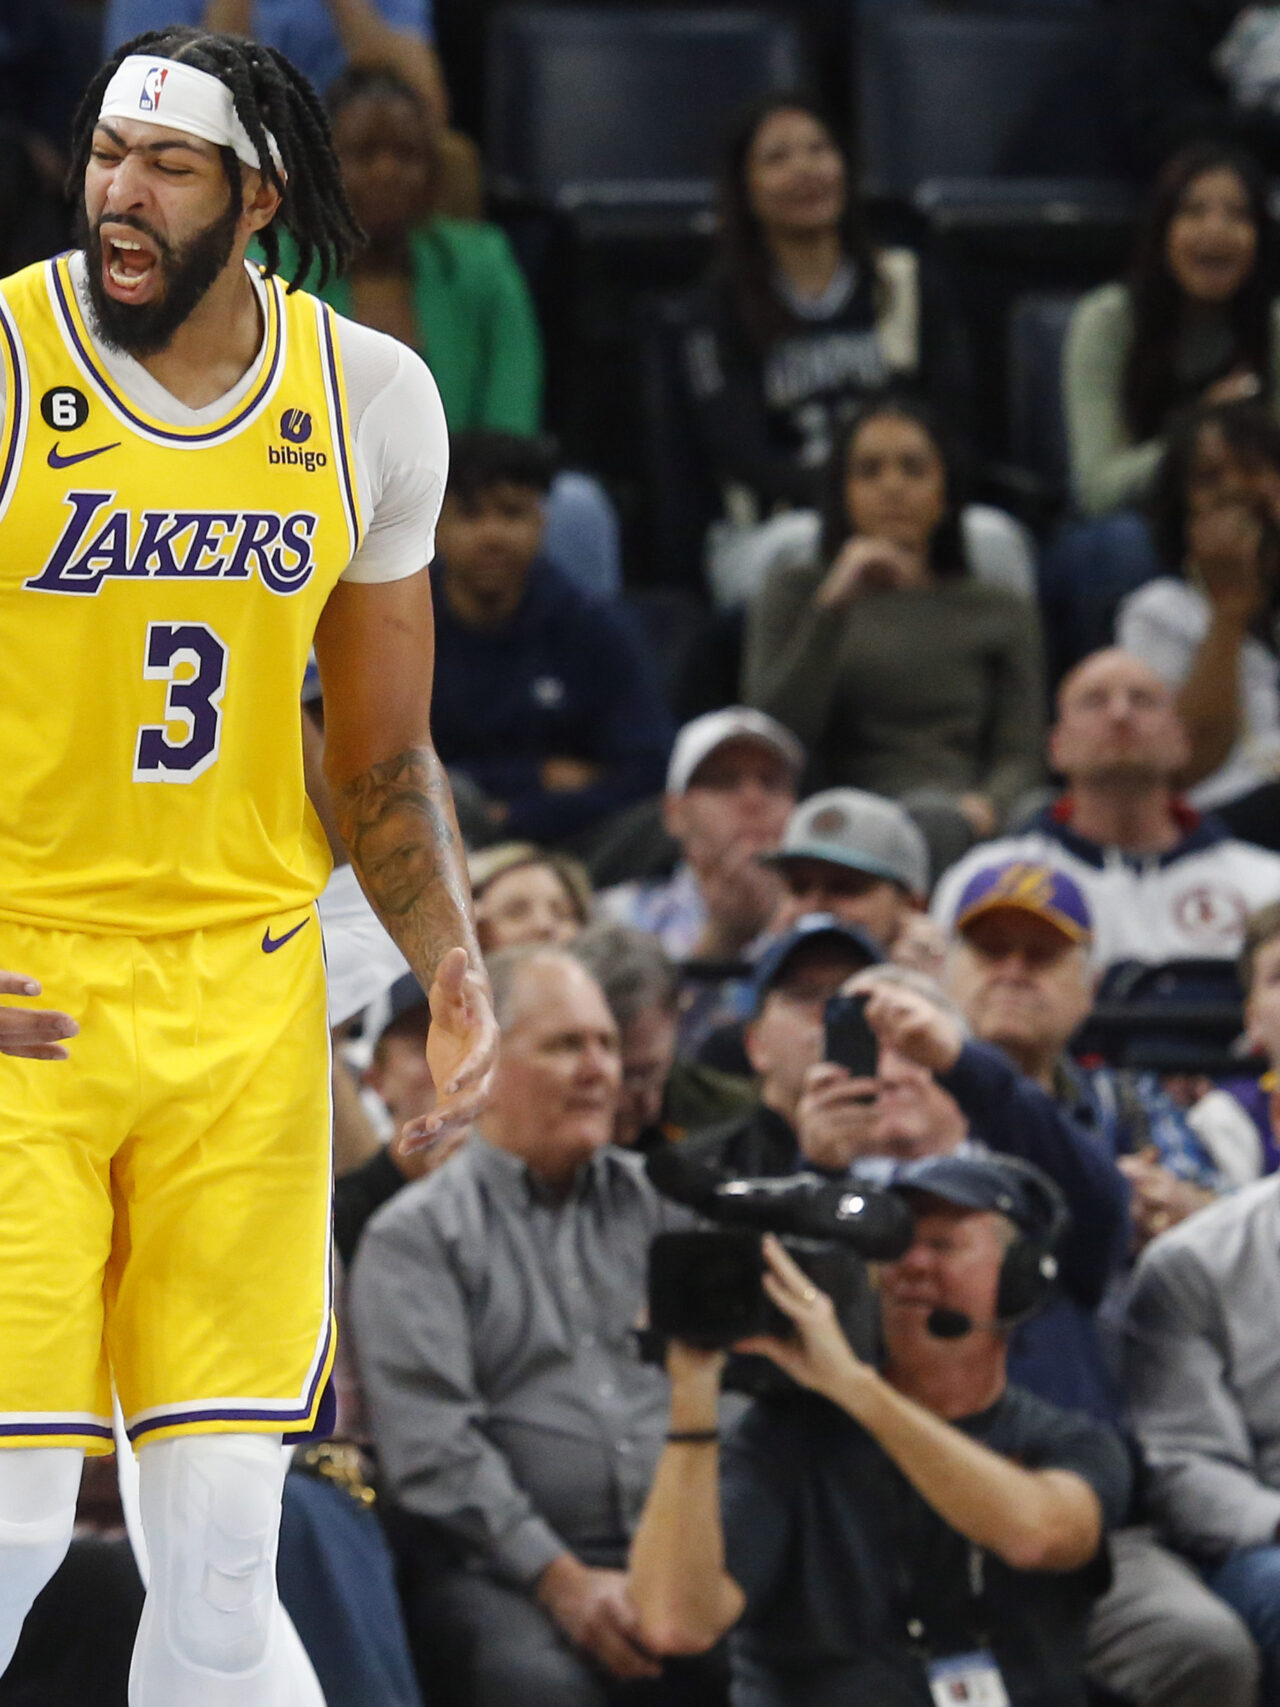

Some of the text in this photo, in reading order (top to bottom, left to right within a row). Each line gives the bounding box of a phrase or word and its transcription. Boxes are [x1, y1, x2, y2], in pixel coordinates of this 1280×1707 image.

[51, 393, 77, 427] 6
[268, 445, 327, 472] bibigo
[21, 489, 320, 597] LAKERS
[132, 621, 230, 784] 3
